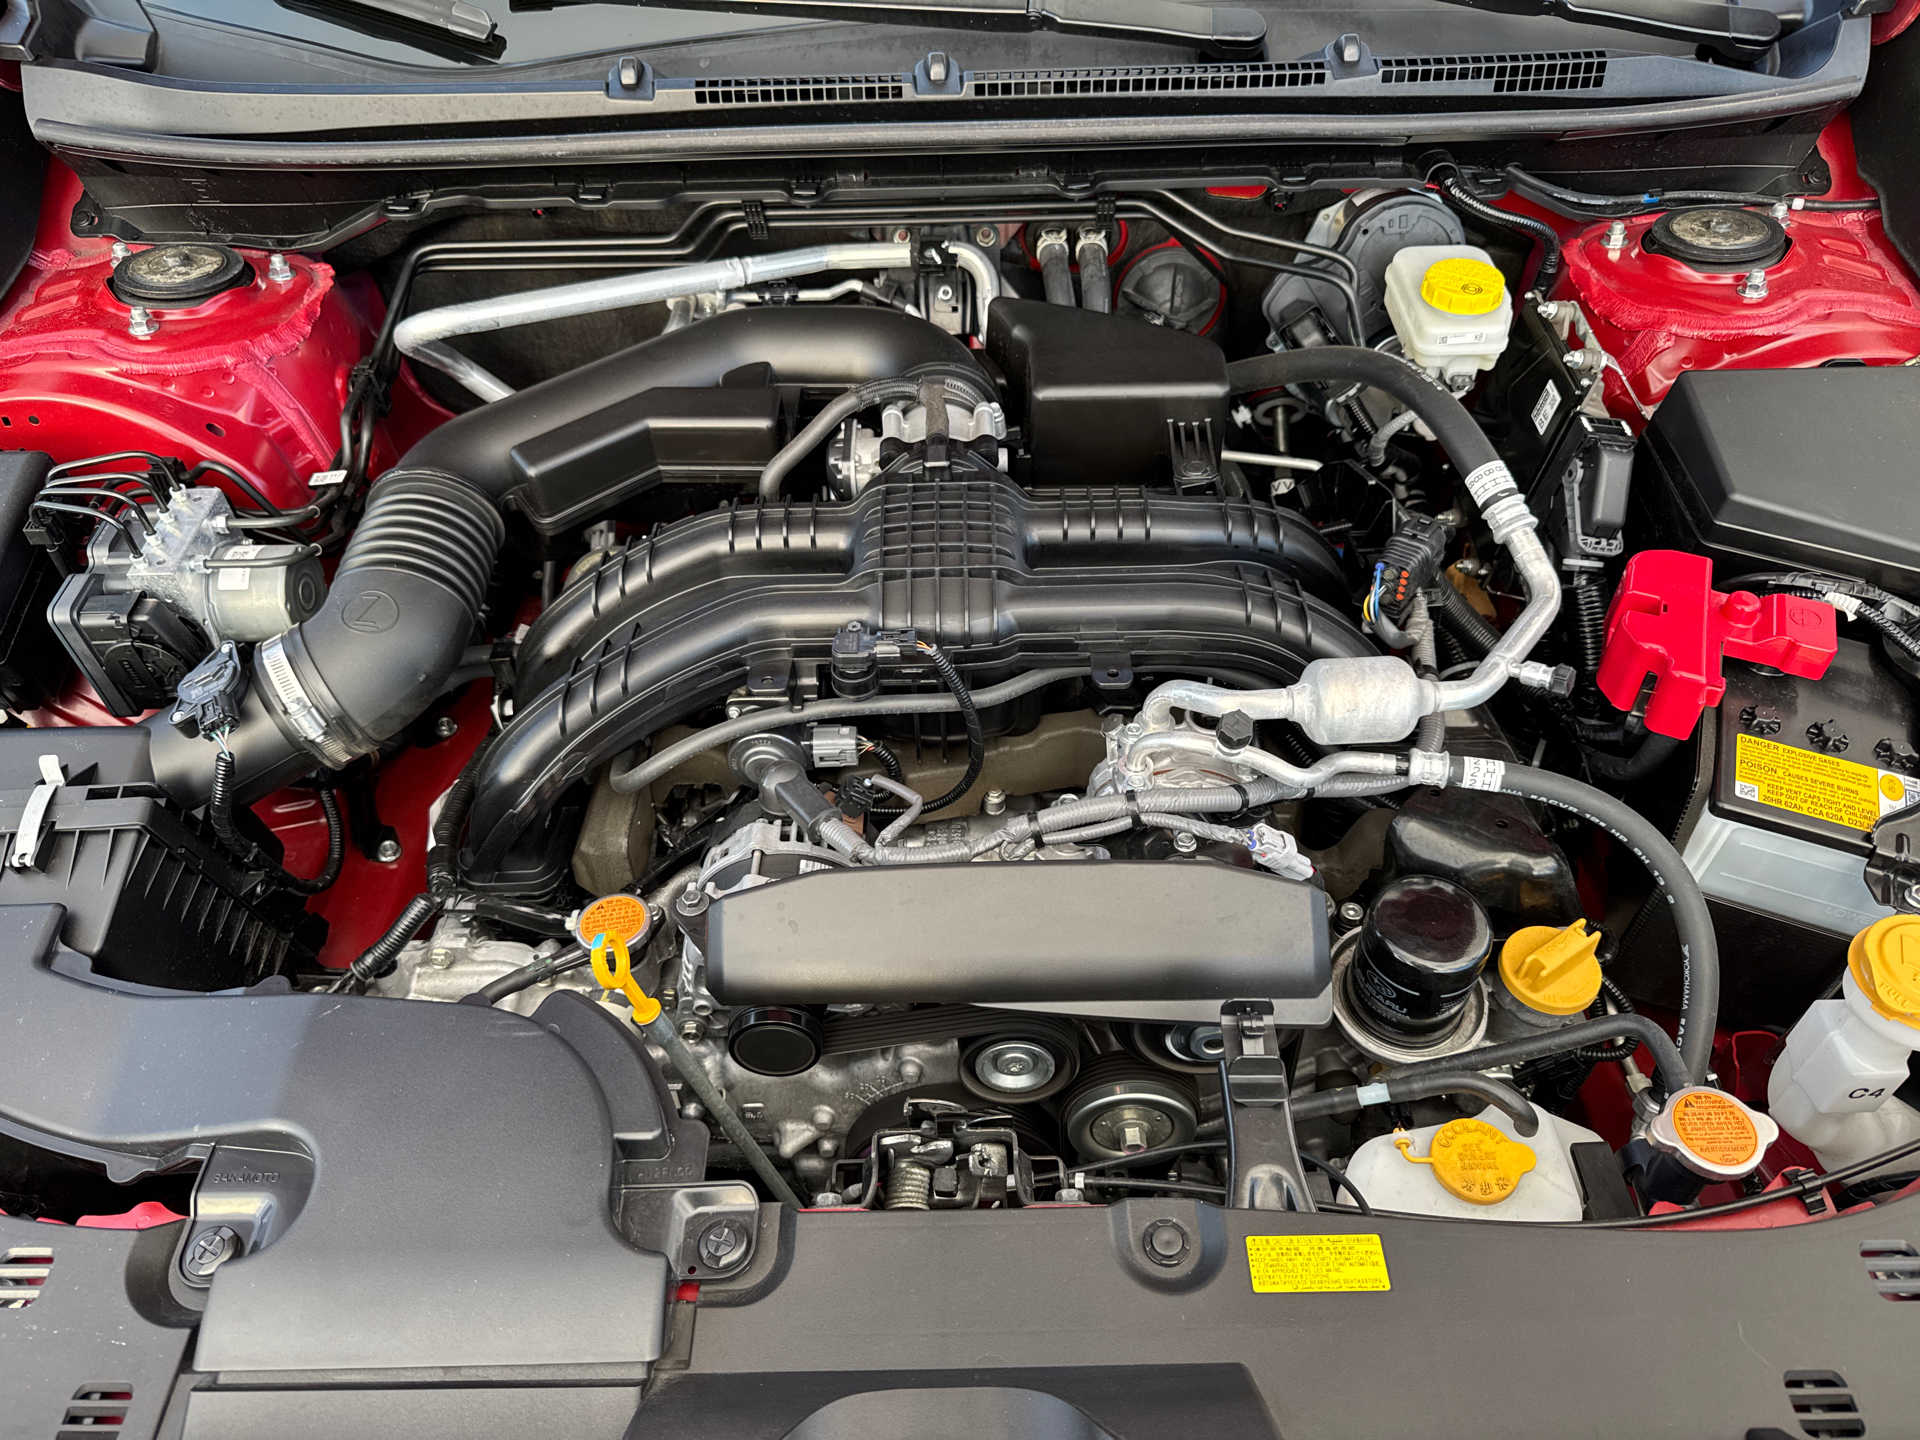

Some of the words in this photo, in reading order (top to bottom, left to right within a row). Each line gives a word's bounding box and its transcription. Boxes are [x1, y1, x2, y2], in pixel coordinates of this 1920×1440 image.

[1740, 735, 1779, 752] DANGER
[1782, 747, 1817, 761] EXPLOSIVE
[1818, 756, 1840, 767] GASES
[1739, 758, 1777, 774] POISON
[1782, 770, 1808, 782] CAUSES
[1809, 777, 1835, 789] SEVERE
[1836, 784, 1859, 796] BURNS
[1762, 793, 1782, 806] 20HR
[1784, 799, 1803, 812] 62Ah
[1806, 805, 1824, 817] CCA
[1825, 811, 1844, 823] 620A
[1766, 782, 1784, 792] KEEP
[1785, 787, 1801, 796] VENT
[1803, 792, 1820, 801] CAPS
[1822, 797, 1841, 807] TIGHT
[1842, 802, 1856, 811] AND
[1857, 806, 1877, 817] LEVEL
[1766, 788, 1784, 798] KEEP
[1785, 793, 1798, 802] OUT
[1810, 799, 1832, 811] REACH
[1354, 968, 1408, 1014] SUBARU
[1682, 958, 1690, 1010] YOKOHAMA
[1848, 1087, 1886, 1099] C4
[1437, 1121, 1508, 1147] COOLANT
[1461, 1142, 1482, 1152] SEE
[213, 1172, 281, 1184] SAKAMOTO
[1460, 1161, 1499, 1171] MANUAL
[1297, 1236, 1324, 1244] ATTENTION
